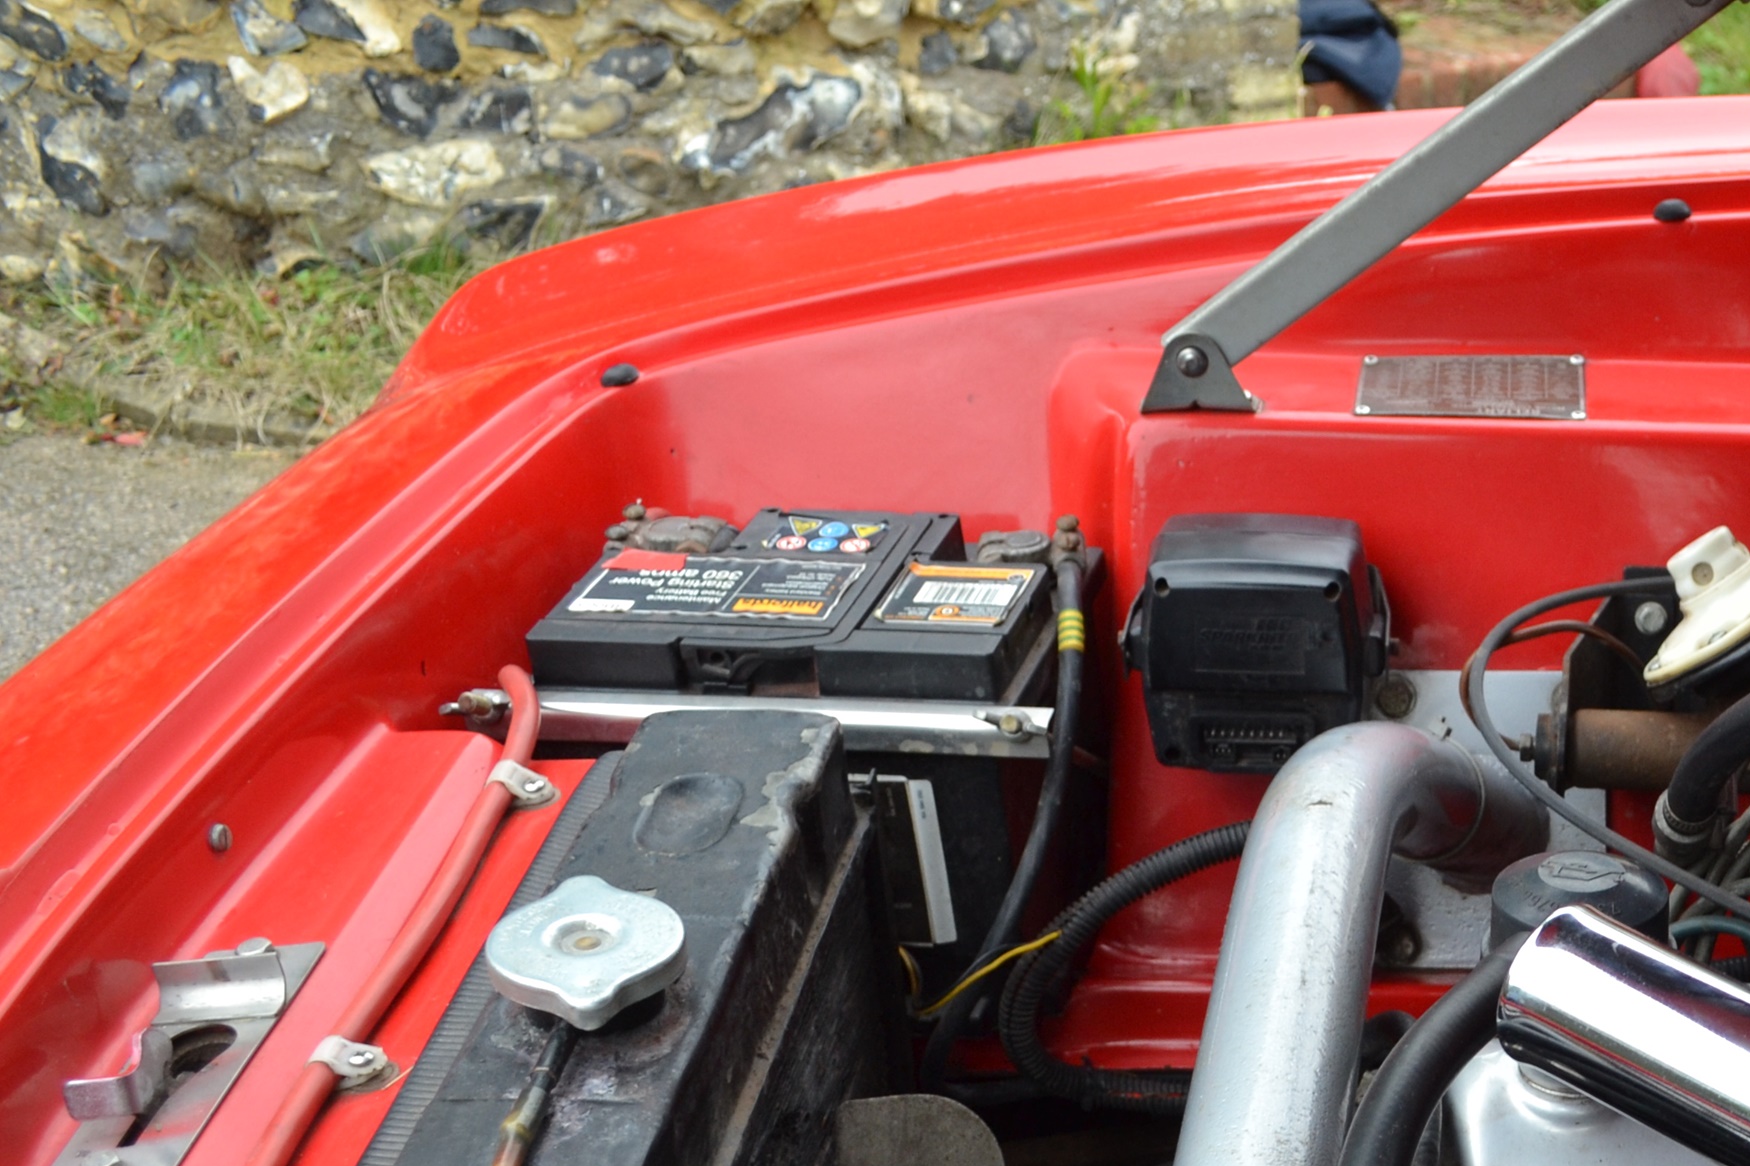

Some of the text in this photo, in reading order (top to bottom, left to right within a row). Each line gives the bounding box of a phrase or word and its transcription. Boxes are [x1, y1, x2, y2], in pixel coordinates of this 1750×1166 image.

[702, 569, 745, 580] 360
[609, 575, 736, 591] Starting Power
[645, 594, 722, 604] Maintenance
